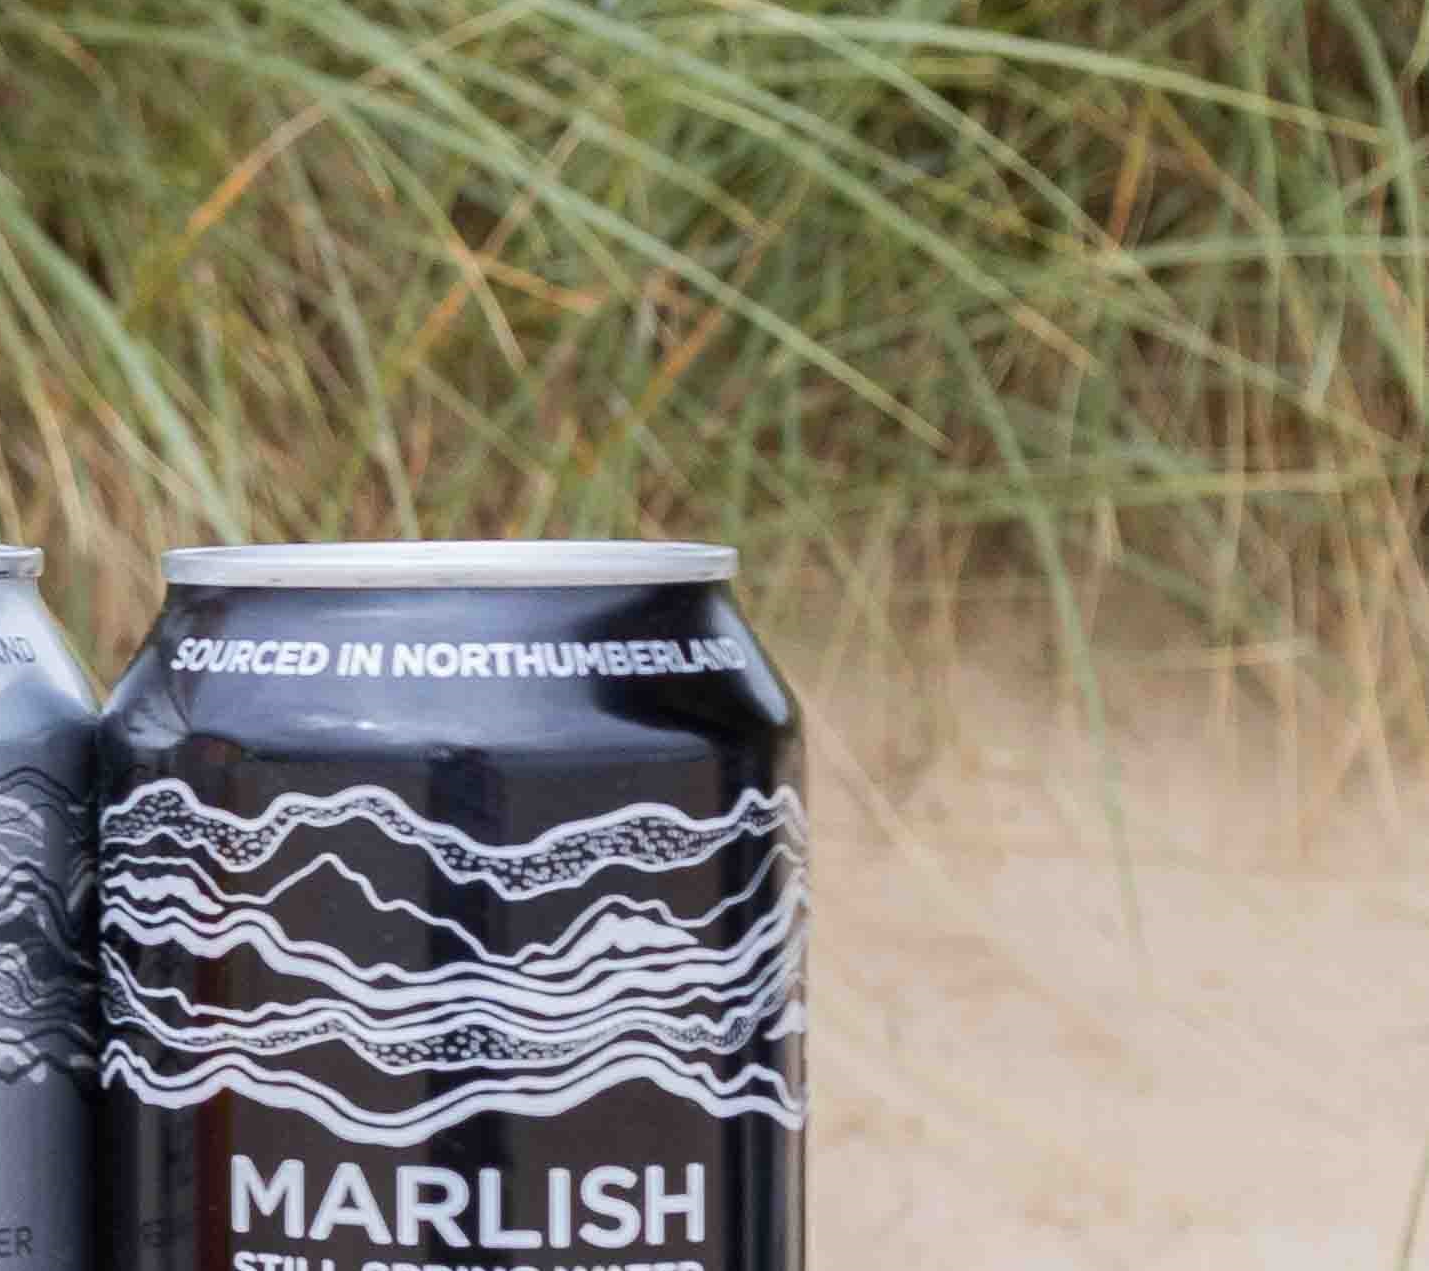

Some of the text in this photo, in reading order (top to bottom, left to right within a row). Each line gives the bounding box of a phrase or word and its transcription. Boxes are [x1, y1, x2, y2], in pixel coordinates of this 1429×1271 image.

[170, 637, 745, 679] SOURCED IN NORTHUMBERLAND
[230, 1154, 705, 1249] MARLISH
